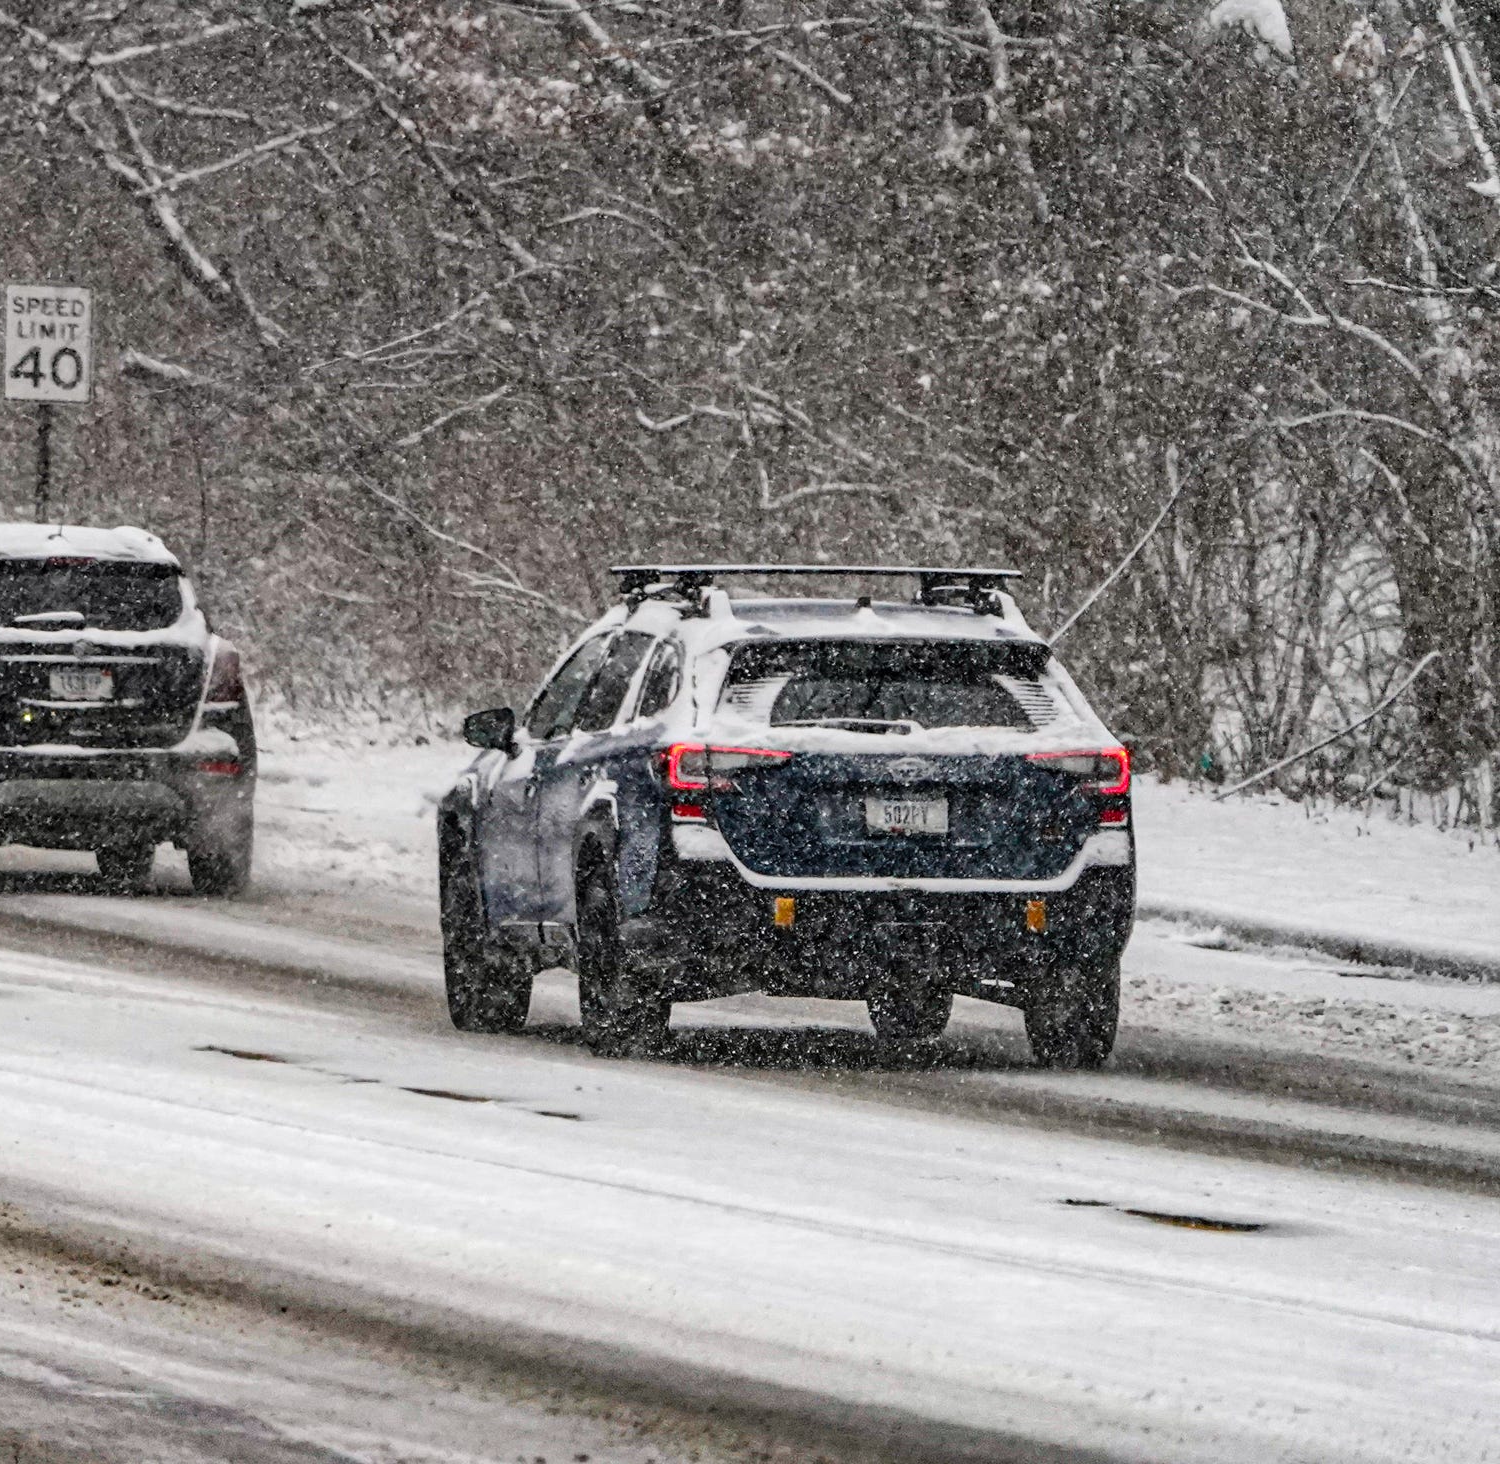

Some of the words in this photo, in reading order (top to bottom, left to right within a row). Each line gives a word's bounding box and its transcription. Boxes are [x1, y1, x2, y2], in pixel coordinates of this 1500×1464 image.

[12, 296, 86, 318] SPEED
[17, 320, 79, 341] LIMIT
[10, 346, 84, 390] 40
